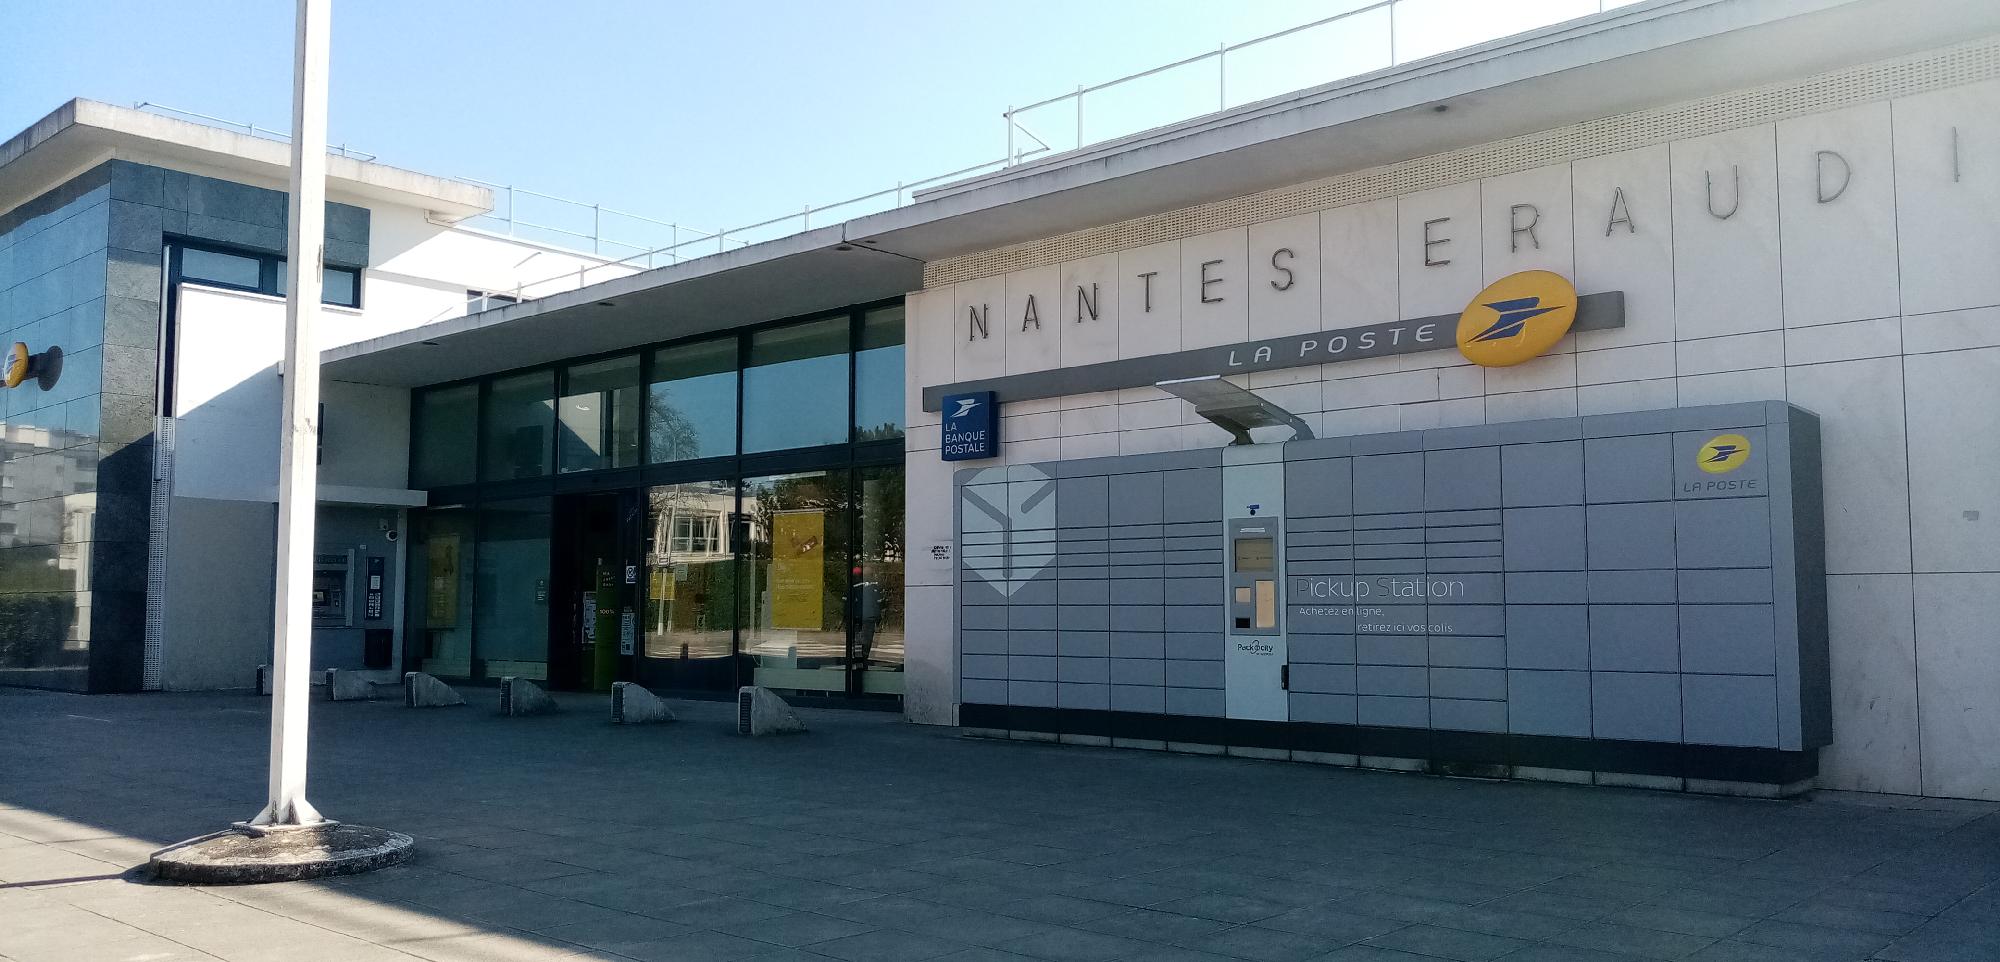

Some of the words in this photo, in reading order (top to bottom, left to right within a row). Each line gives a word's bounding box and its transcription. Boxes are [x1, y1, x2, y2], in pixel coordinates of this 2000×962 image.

[968, 246, 1295, 342] NANTES
[1424, 126, 1962, 267] ERAUDI
[1229, 346, 1272, 367] LA
[1299, 323, 1436, 358] POSTE
[945, 422, 958, 432] LA
[945, 430, 986, 444] BANQUE
[945, 442, 985, 455] POSTALE
[1683, 481, 1702, 493] LA
[1706, 479, 1757, 492] POSTE
[1296, 577, 1370, 602] Pickup
[1376, 576, 1464, 598] Station
[1299, 607, 1340, 616] Achetez
[1342, 608, 1354, 616] en
[1357, 623, 1391, 633] retirez
[1393, 623, 1405, 632] ici
[1408, 623, 1426, 632] vos
[1427, 622, 1453, 633] colis
